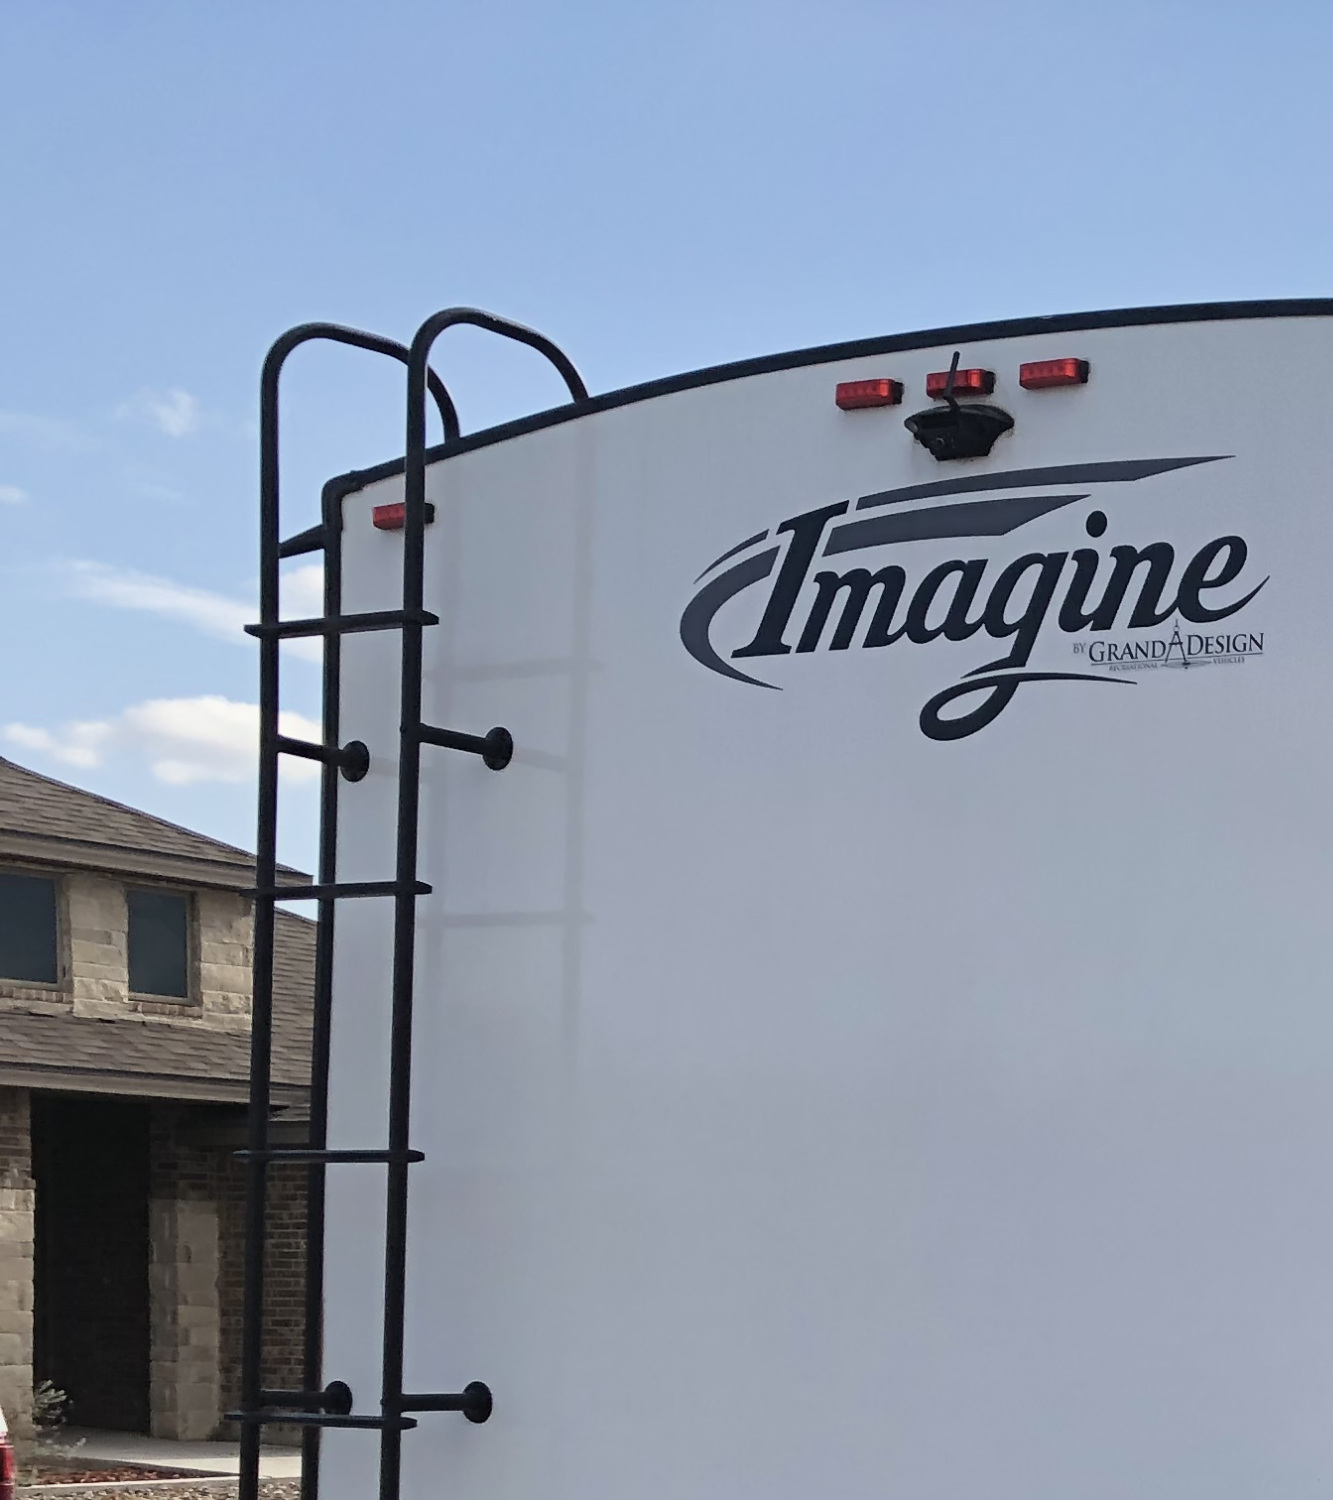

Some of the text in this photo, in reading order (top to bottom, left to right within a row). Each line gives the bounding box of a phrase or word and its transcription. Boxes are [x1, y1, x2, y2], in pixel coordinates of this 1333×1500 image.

[730, 500, 1270, 741] Imagine
[1073, 633, 1265, 664] BY GRAND DESIGN
